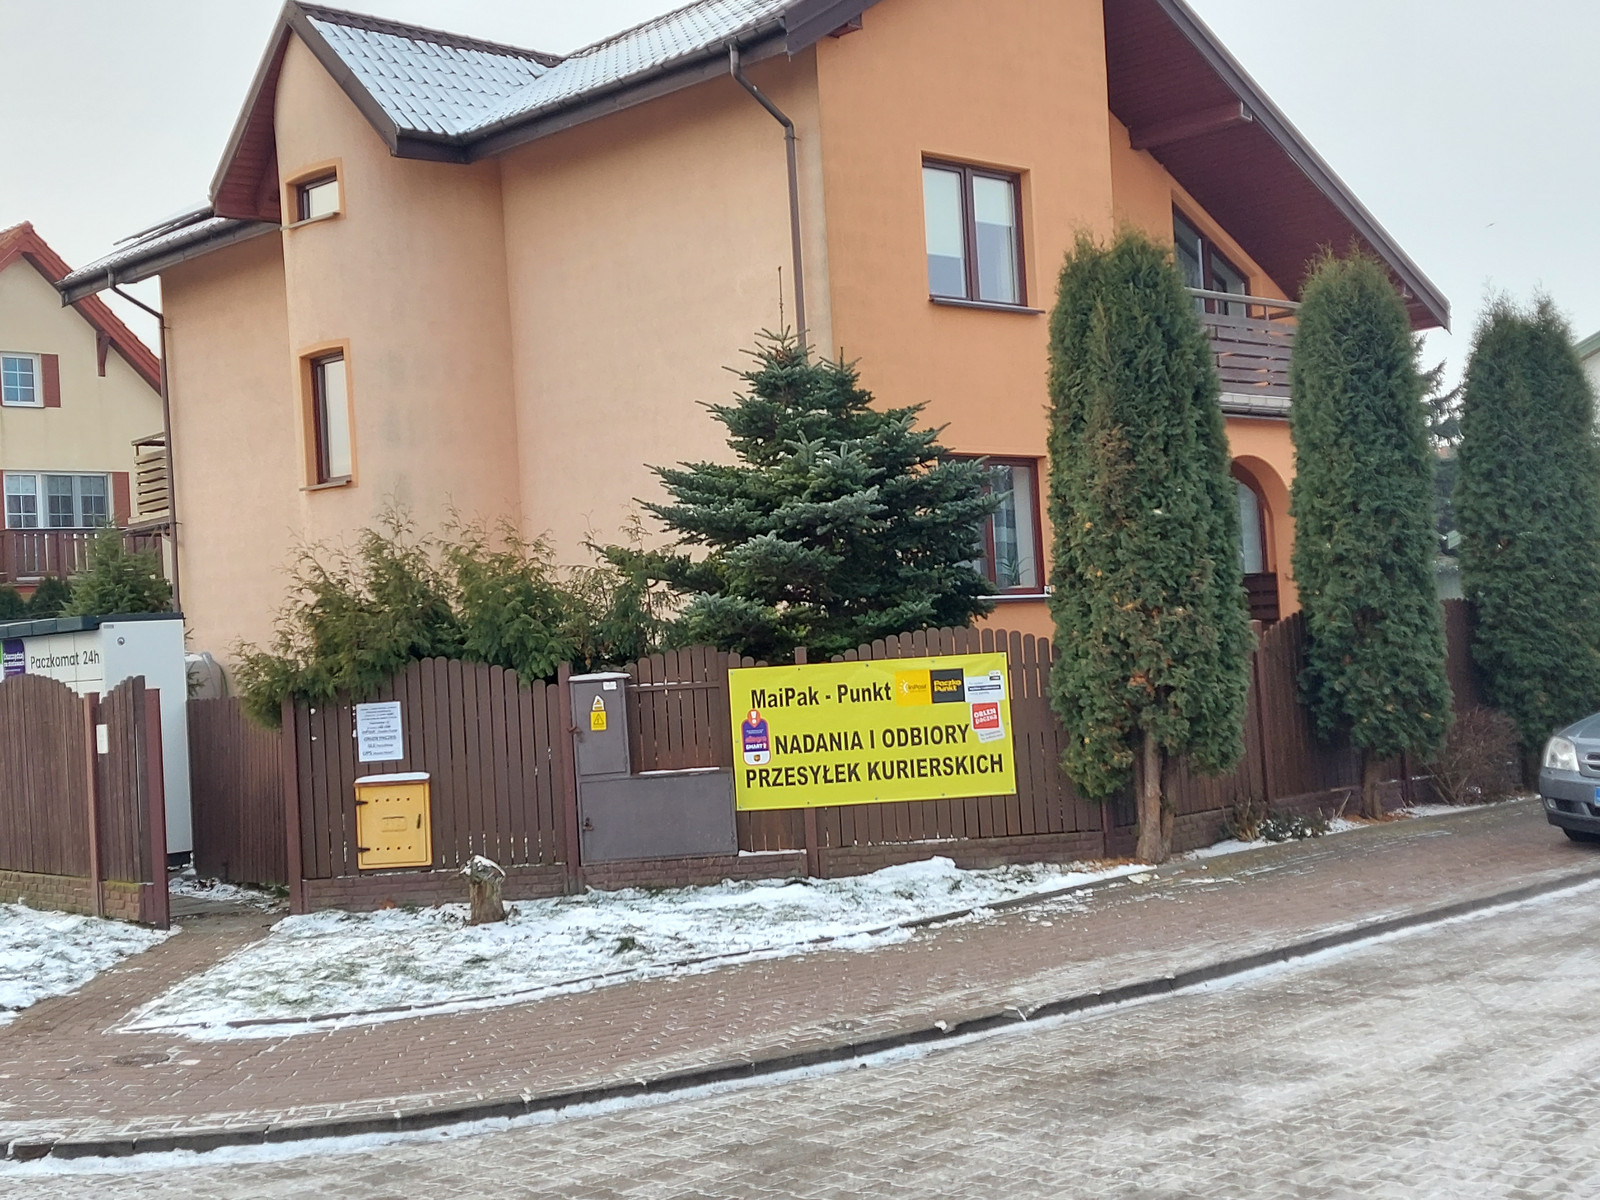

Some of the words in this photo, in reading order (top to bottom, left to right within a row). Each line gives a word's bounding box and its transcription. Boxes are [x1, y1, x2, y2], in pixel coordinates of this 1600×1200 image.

[30, 653, 80, 669] Paczkomat
[82, 650, 100, 665] 24h
[751, 685, 820, 709] MaiPak
[837, 681, 892, 704] Punkt
[973, 707, 997, 718] ORLEN
[774, 731, 864, 755] NADANIA
[869, 729, 876, 749] I
[881, 723, 970, 749] ODBIORY
[745, 762, 861, 788] PRZESYŁEK
[867, 753, 1004, 781] KURIERSKICH
